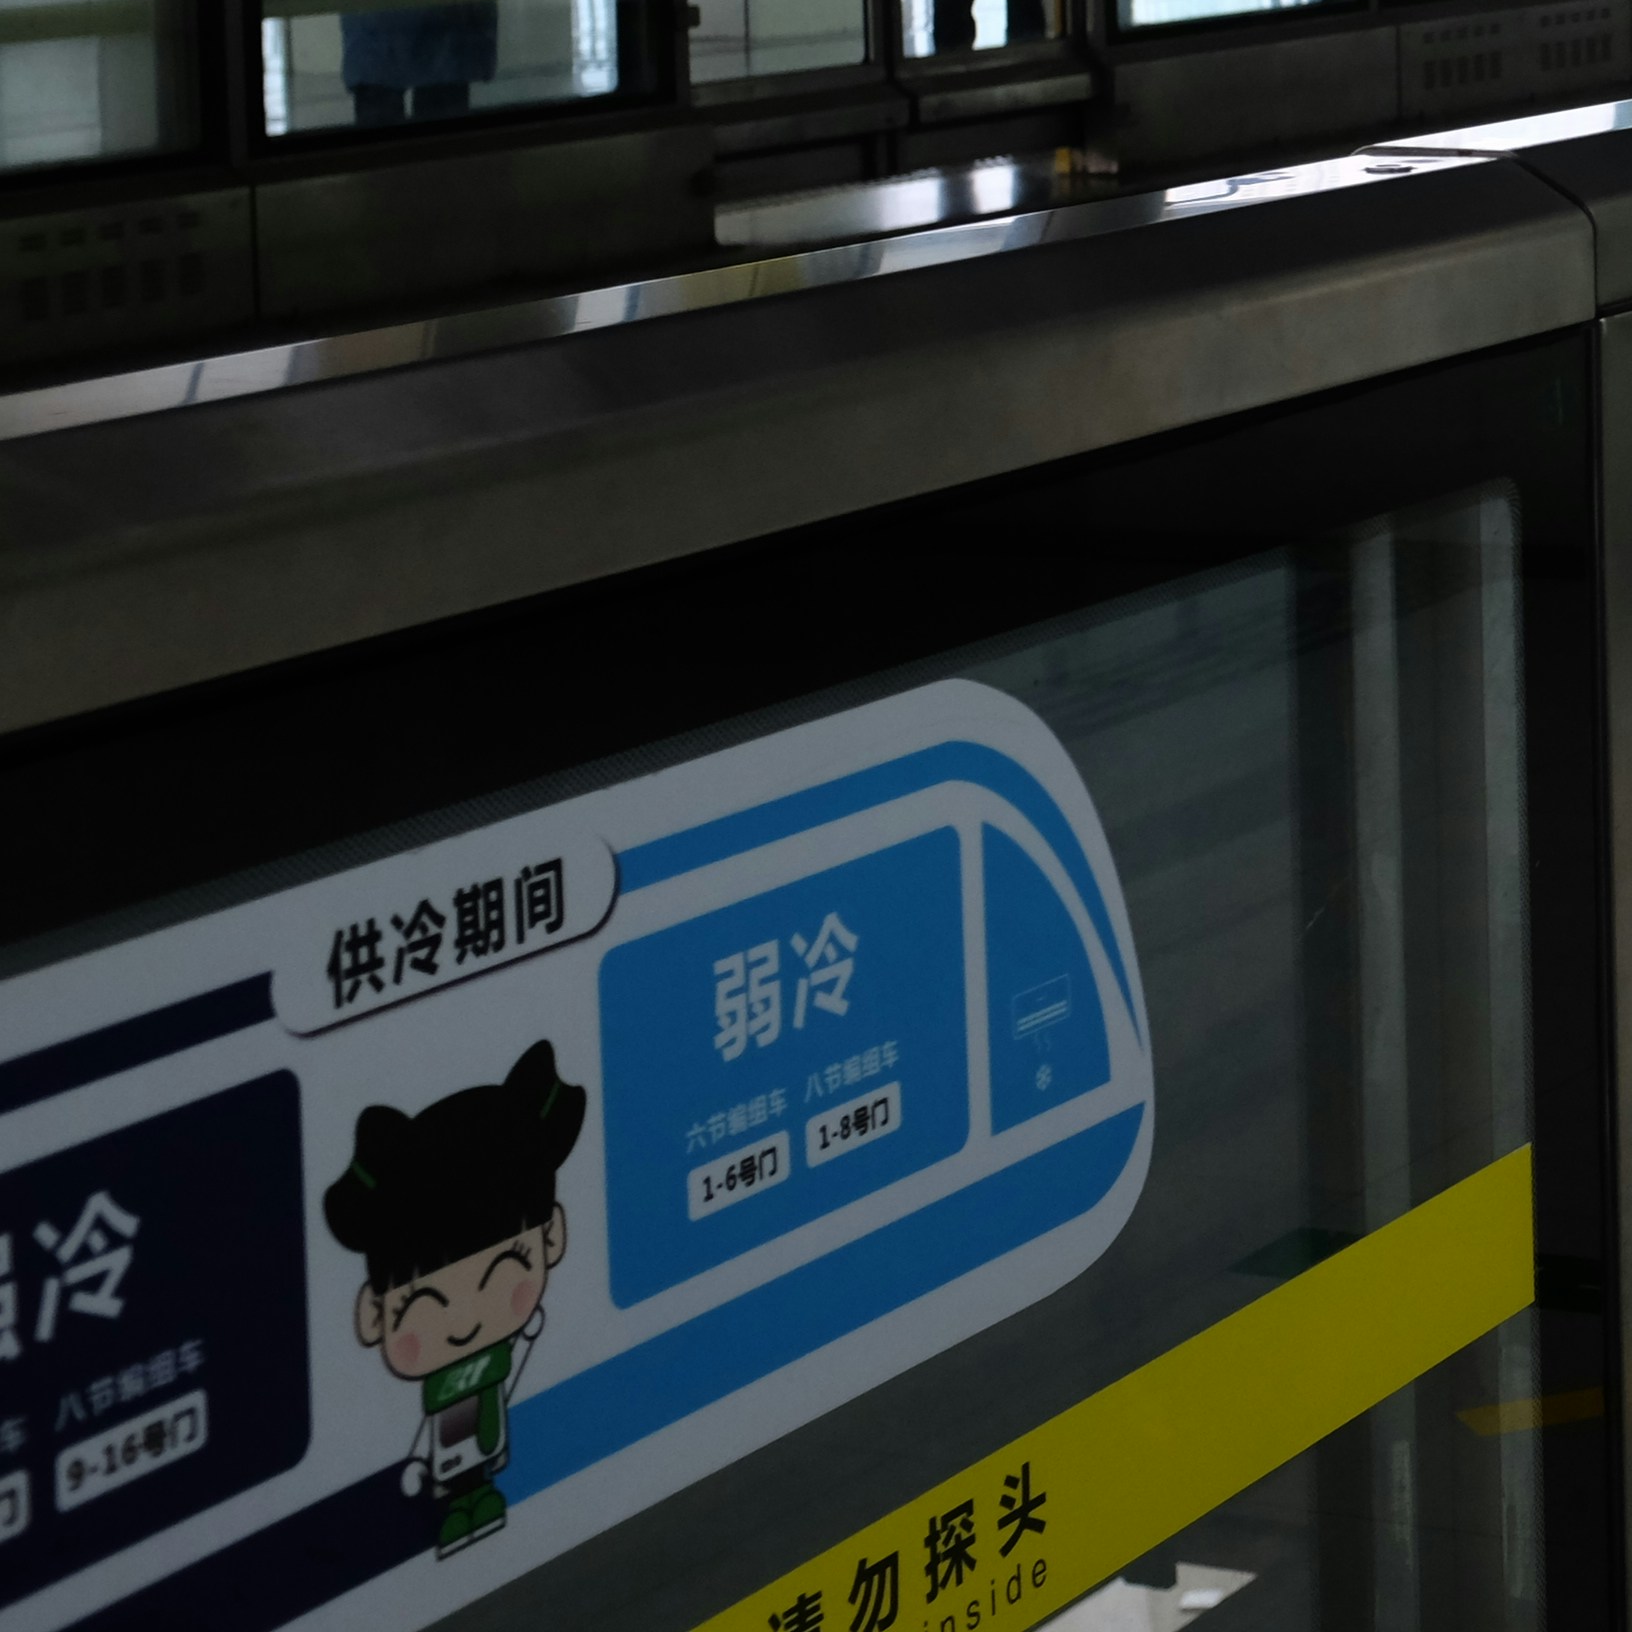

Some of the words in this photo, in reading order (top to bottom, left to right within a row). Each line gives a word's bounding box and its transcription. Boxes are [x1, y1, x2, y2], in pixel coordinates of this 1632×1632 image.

[327, 858, 564, 1009] 供冷期间
[712, 911, 860, 1062] 弱冷
[804, 1039, 899, 1104] 八节编组车
[685, 1087, 788, 1154] 六节编组车
[819, 1096, 889, 1150] 1-8号门
[702, 1145, 777, 1203] 1-6号门
[0, 1190, 142, 1361] 冷
[53, 1337, 205, 1434] 八节编组车
[67, 1406, 200, 1492] 9-16号门
